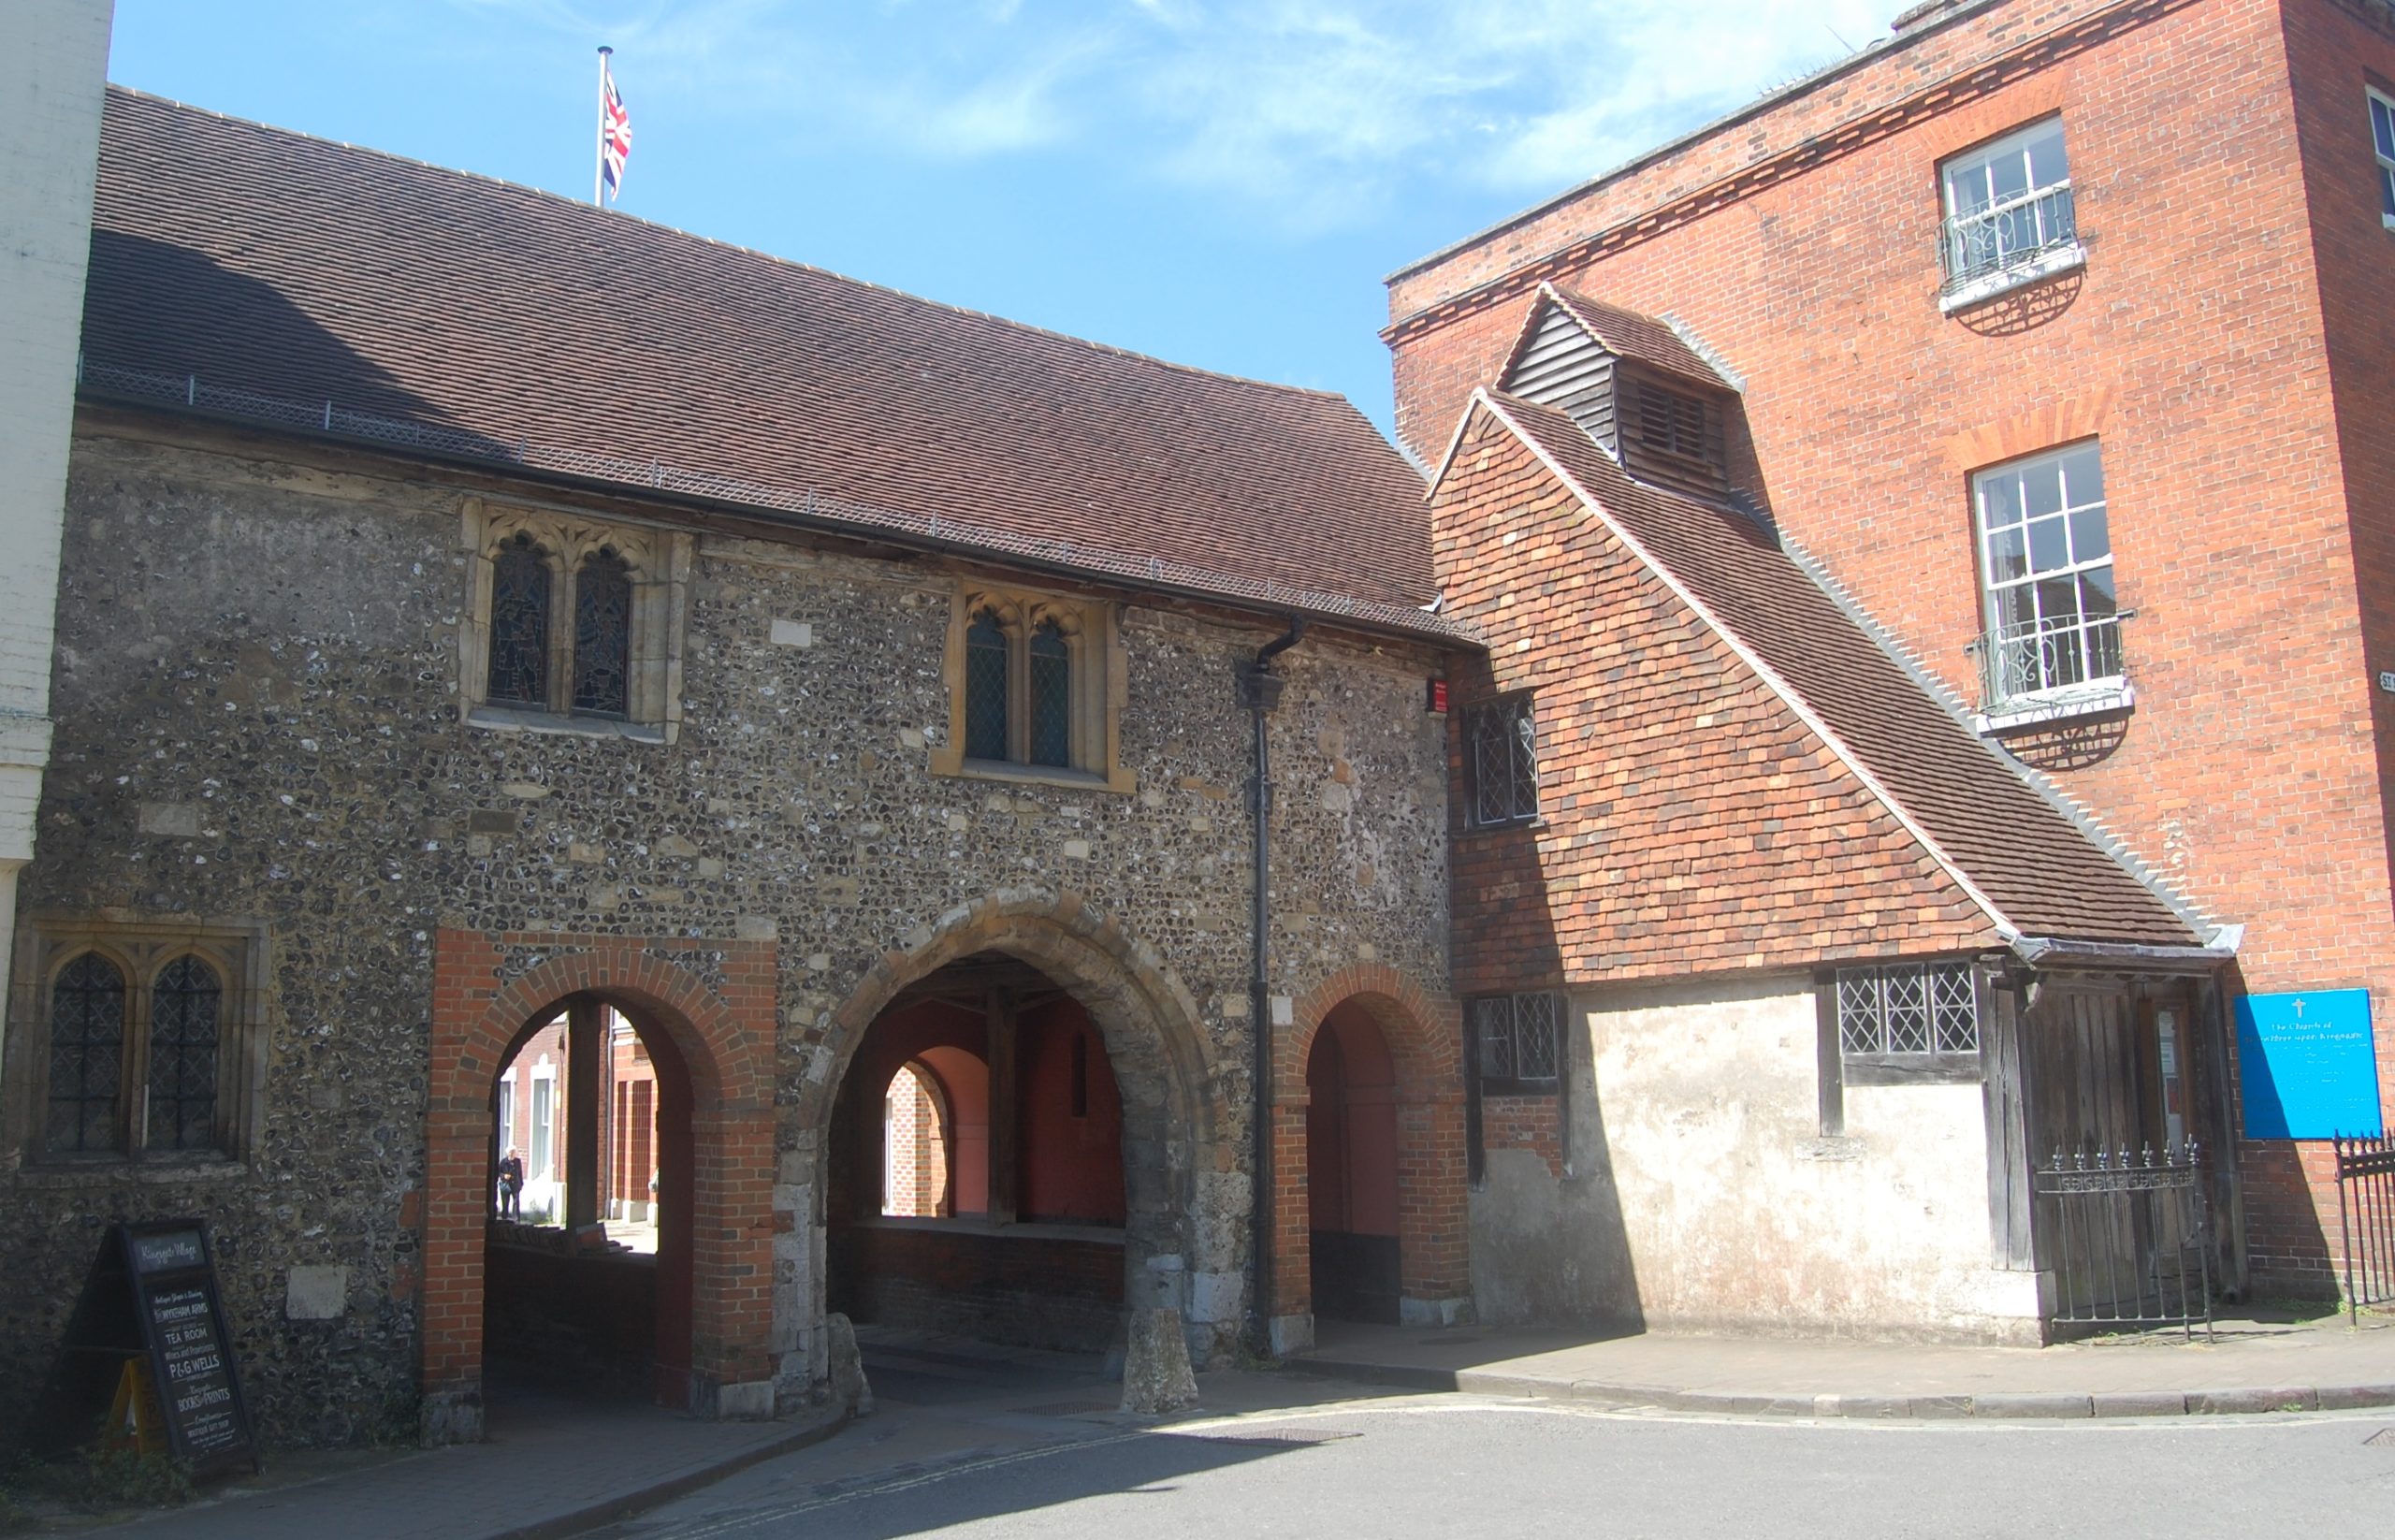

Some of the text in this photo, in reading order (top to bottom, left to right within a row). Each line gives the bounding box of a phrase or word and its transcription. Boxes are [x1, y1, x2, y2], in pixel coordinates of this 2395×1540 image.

[2289, 1021, 2320, 1030] Church
[166, 1331, 182, 1344] TEA
[184, 1326, 208, 1342] ROOM
[191, 1354, 220, 1373] WELLS
[178, 1387, 231, 1413] BOOKS PRINTS
